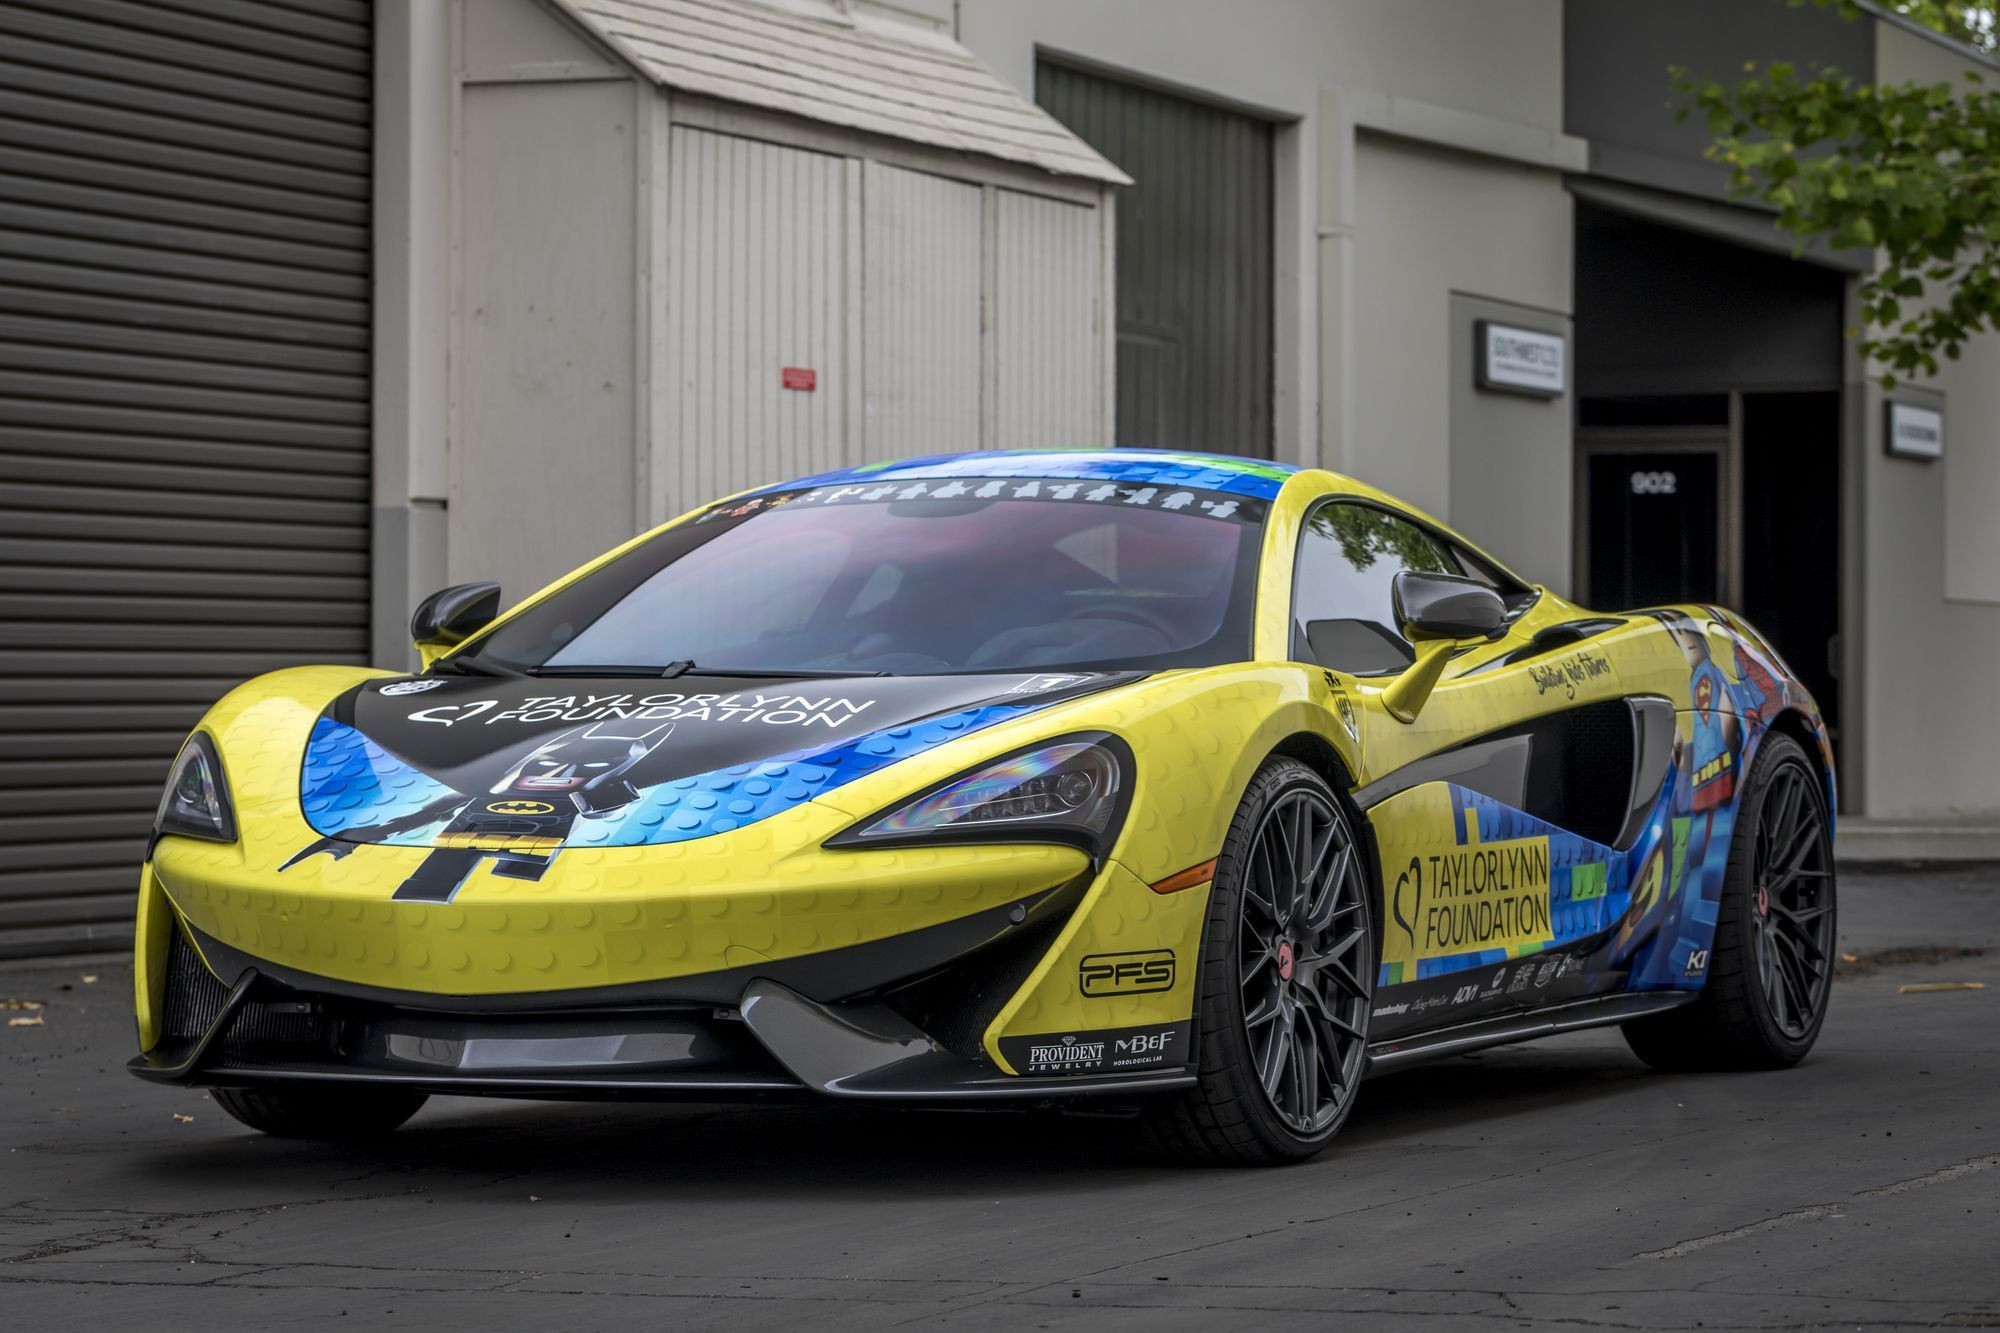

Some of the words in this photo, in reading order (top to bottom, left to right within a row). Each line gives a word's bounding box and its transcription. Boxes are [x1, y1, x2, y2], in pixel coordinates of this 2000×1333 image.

[1630, 471, 1677, 495] 902
[522, 693, 876, 714] TAYLORLYNN
[485, 706, 853, 728] FOUNDATION
[1429, 843, 1547, 899] TAYLORLYNN
[1426, 892, 1549, 949] FOUNDATION
[1030, 1044, 1104, 1062] PROVIDENT
[1115, 1031, 1175, 1054] MB&F
[1029, 1061, 1102, 1071] JEWELRY
[1113, 1057, 1151, 1066] HOROLOGICAL
